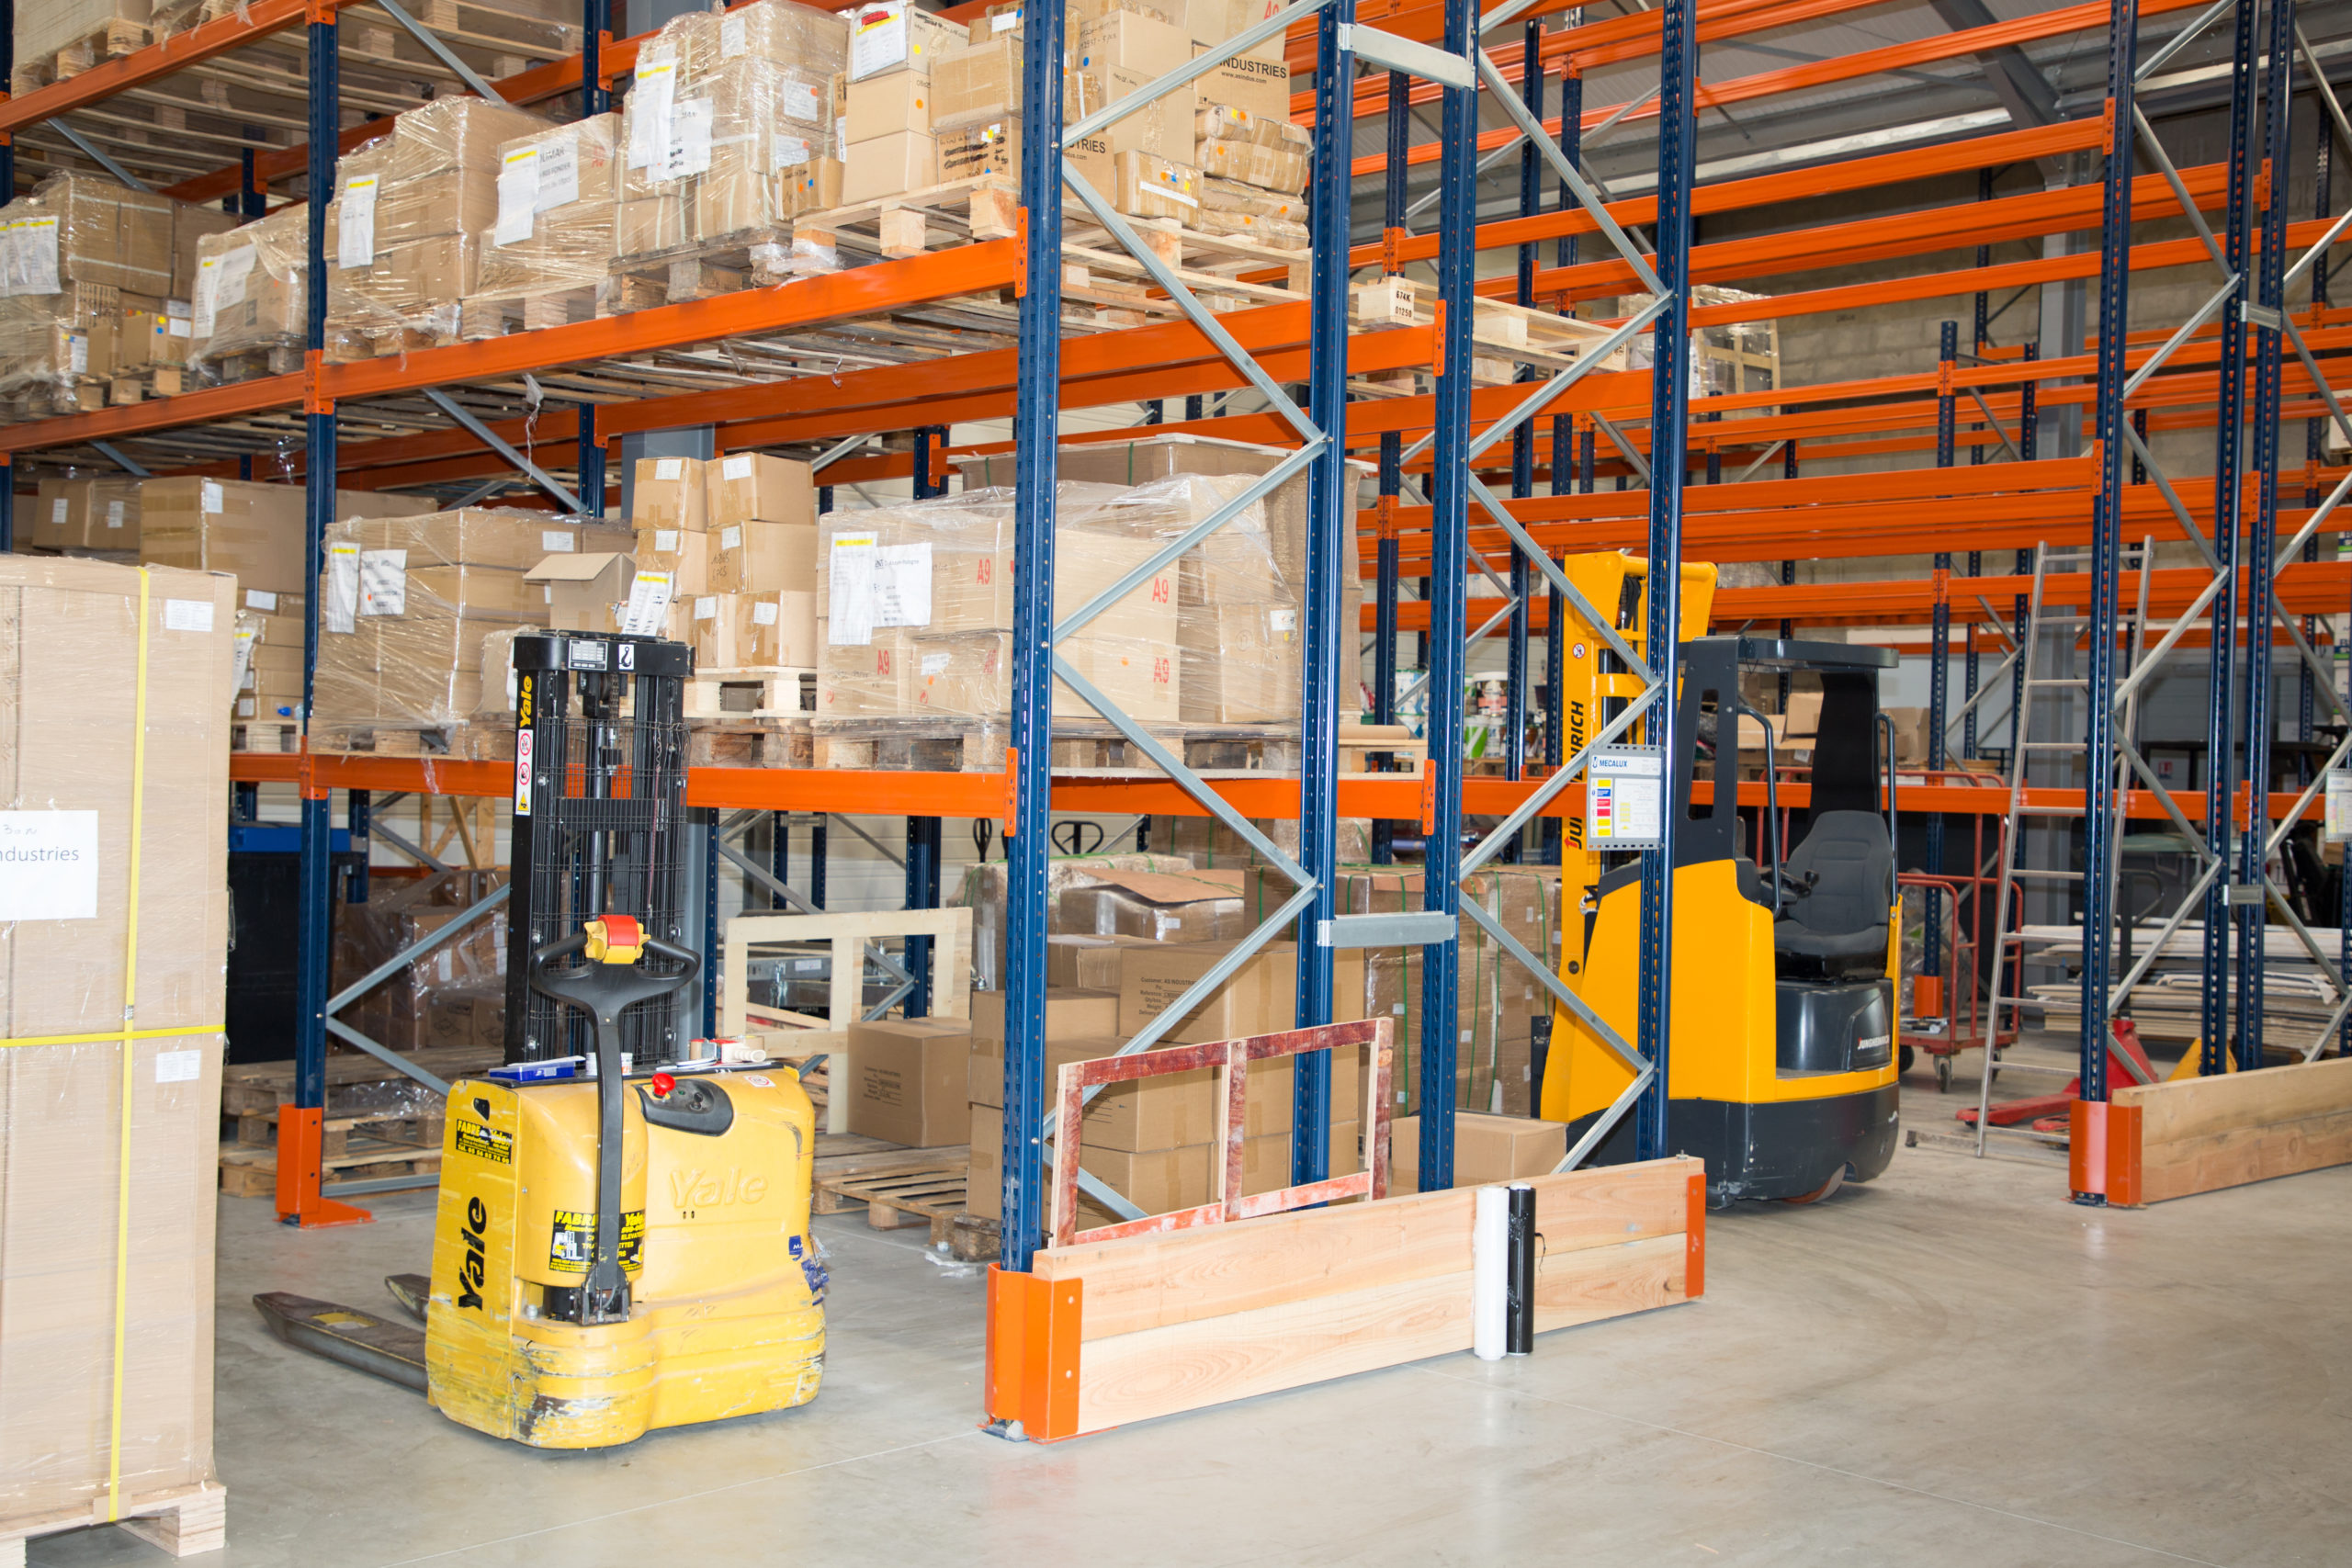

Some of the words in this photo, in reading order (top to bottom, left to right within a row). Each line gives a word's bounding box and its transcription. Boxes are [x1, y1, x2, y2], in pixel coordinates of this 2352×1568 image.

[1221, 72, 1267, 84] www.asindus.com
[976, 558, 991, 585] A9
[1151, 577, 1170, 604] A9
[876, 649, 890, 675] A9
[1153, 657, 1170, 683] A9
[520, 675, 532, 728] Yale
[1599, 759, 1628, 768] MECALUX
[458, 1120, 481, 1137] FABRE
[669, 1167, 769, 1210] Yale
[458, 1196, 486, 1311] Yale
